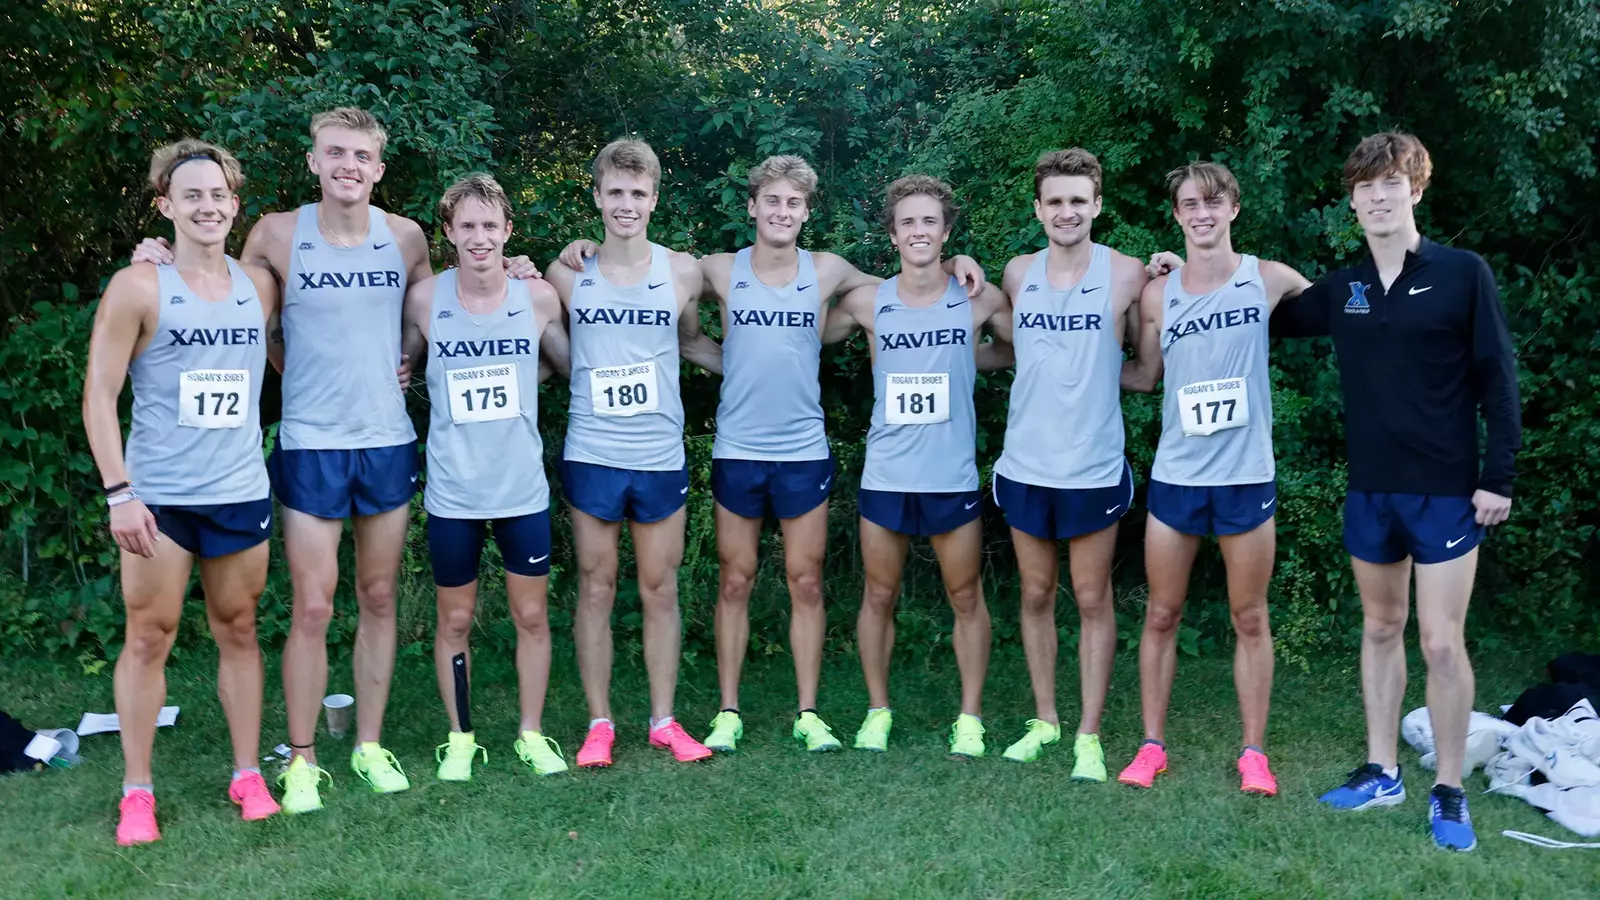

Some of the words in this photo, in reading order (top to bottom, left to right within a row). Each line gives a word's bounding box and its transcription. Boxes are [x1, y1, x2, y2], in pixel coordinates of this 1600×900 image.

[298, 270, 401, 290] XAVIER
[574, 308, 671, 327] XAVIER
[731, 309, 816, 328] XAVIER
[1018, 312, 1102, 332] XAVIER
[1166, 307, 1261, 343] XAVIER
[169, 328, 260, 347] XAVIER
[879, 328, 967, 352] XAVIER
[435, 338, 532, 358] XAVIER
[452, 369, 485, 382] ROGAN'S
[486, 366, 510, 378] SHOES
[595, 368, 626, 379] ROGAN'S
[628, 365, 650, 376] SHOES
[891, 375, 919, 385] ROGAN'S
[921, 375, 943, 385] SHOES
[603, 383, 648, 408] 180
[1216, 380, 1241, 391] SHOES
[194, 392, 239, 416] 172
[461, 385, 508, 412] 175
[896, 392, 935, 415] 181
[1191, 399, 1237, 425] 177
